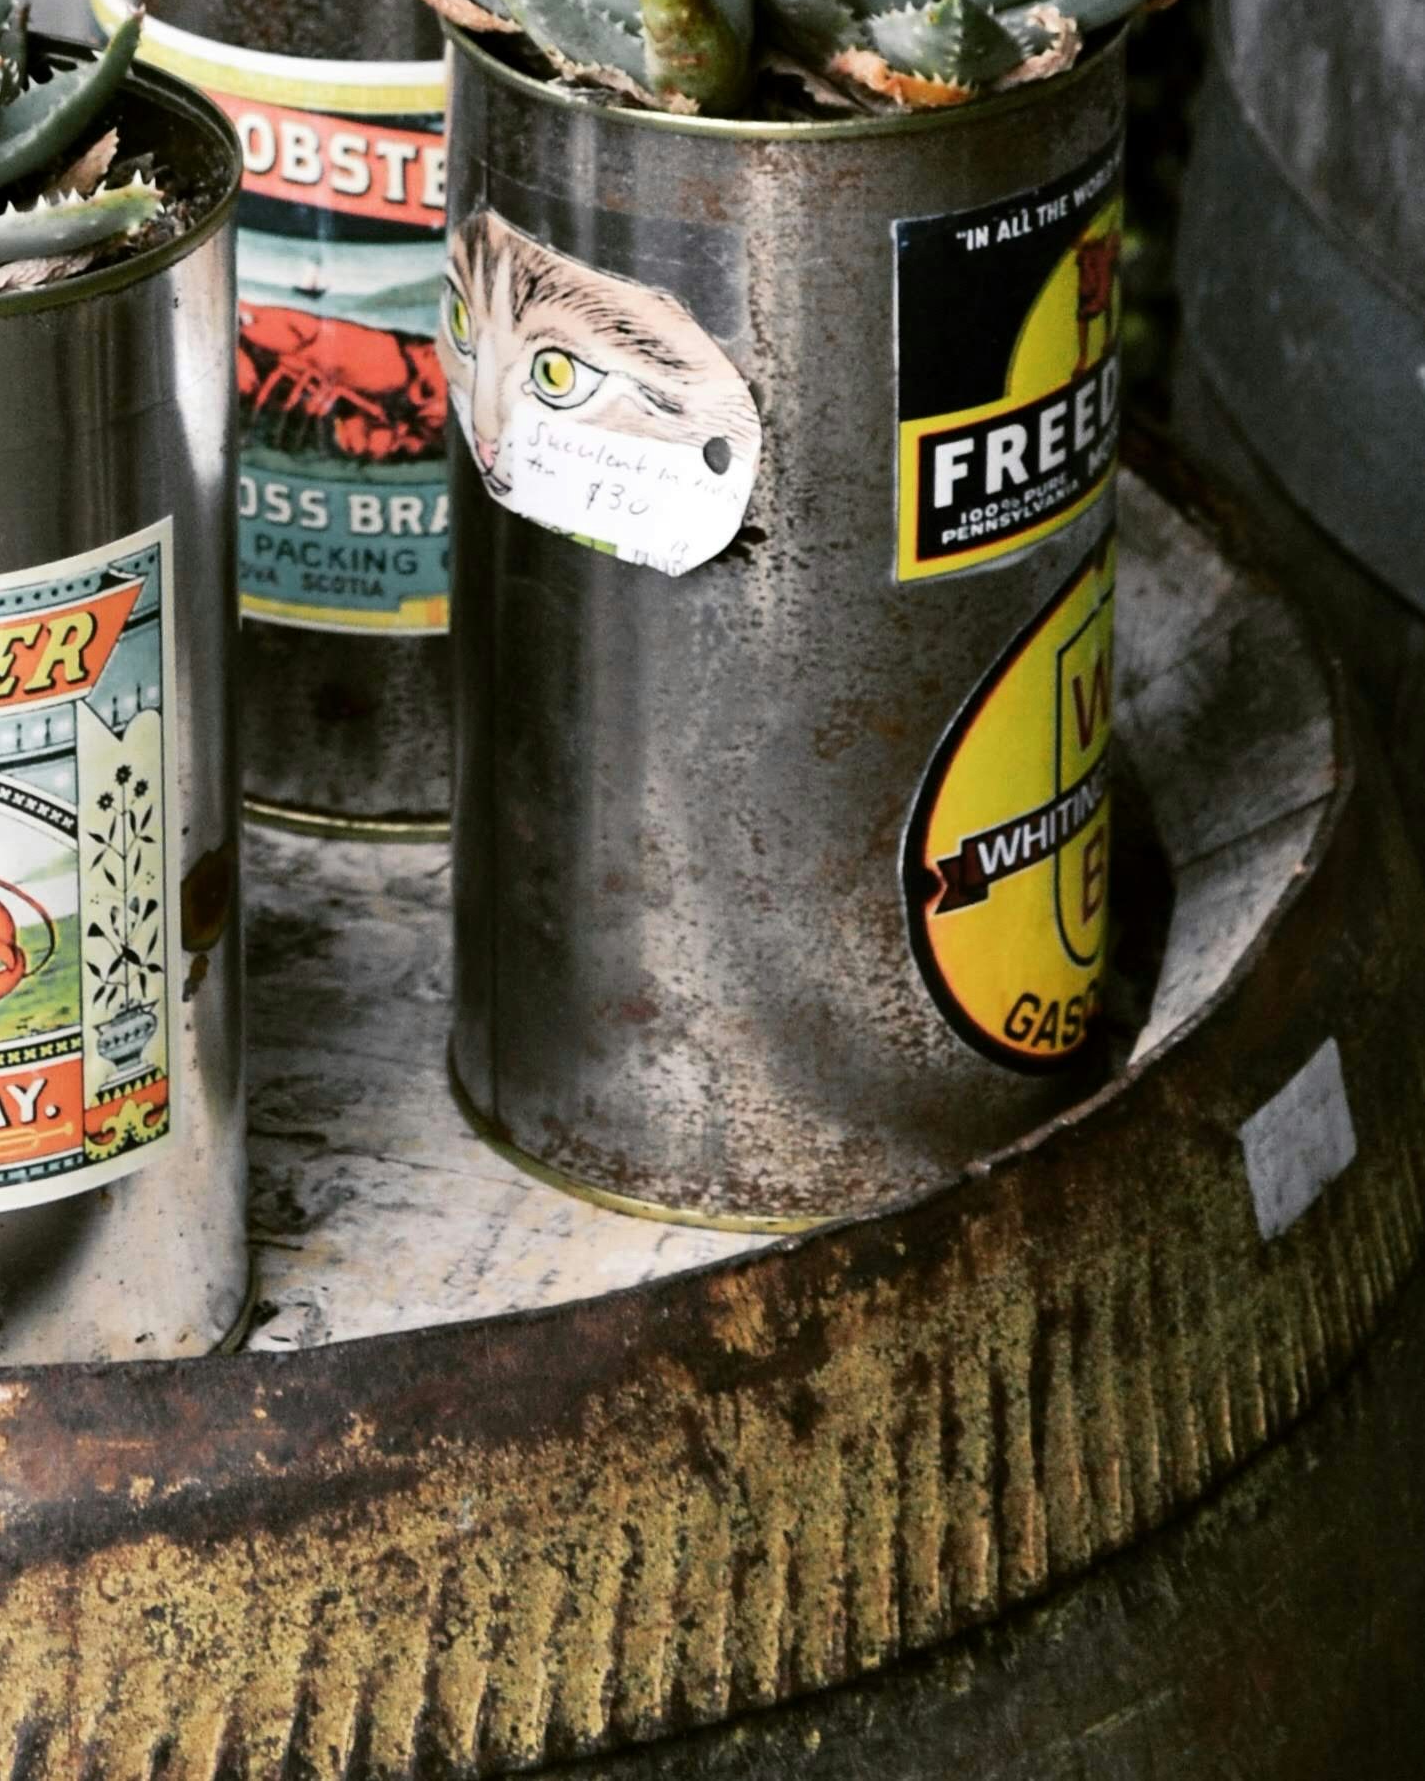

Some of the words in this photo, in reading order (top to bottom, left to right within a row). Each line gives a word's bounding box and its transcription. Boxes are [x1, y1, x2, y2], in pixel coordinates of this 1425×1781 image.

[996, 208, 1033, 243] ALL
[1036, 193, 1068, 227] THE
[527, 421, 648, 474] Succulent
[585, 479, 651, 516] $30
[960, 496, 1021, 526] 100%
[1024, 471, 1068, 504] PURE
[255, 533, 418, 575] PACKING
